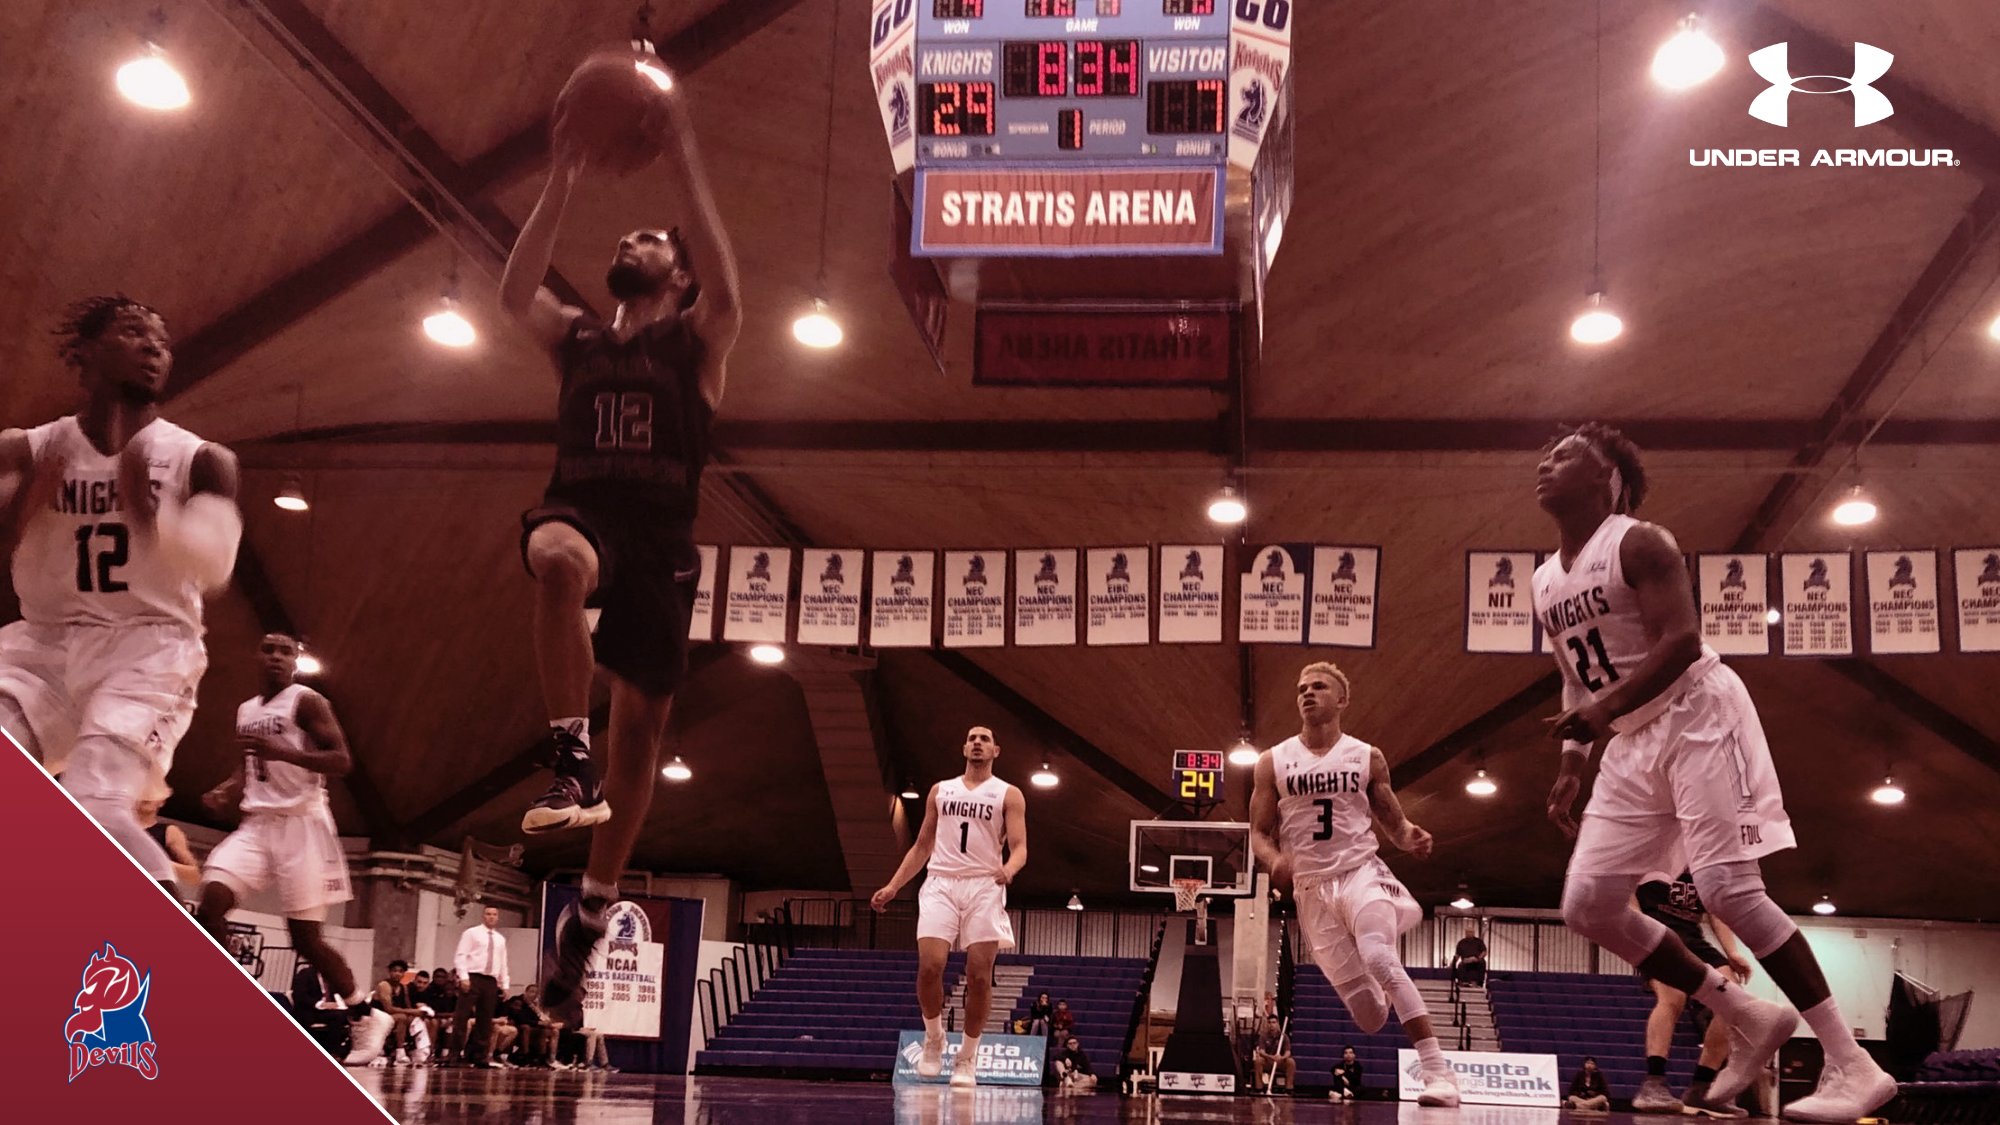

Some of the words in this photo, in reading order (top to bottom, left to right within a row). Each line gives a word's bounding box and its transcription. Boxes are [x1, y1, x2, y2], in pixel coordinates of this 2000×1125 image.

[943, 20, 970, 34] WON
[1066, 18, 1098, 32] GAME
[1173, 16, 1201, 31] WON
[921, 50, 993, 76] KNIGHTS
[1149, 47, 1226, 73] VISITOR
[933, 82, 994, 135] 29
[1196, 79, 1224, 133] 7
[1073, 109, 1081, 149] 1
[1089, 118, 1126, 136] PERIOD
[932, 141, 968, 157] BONUS
[1175, 139, 1211, 156] BONUS
[941, 189, 1076, 228] STRATIS
[1085, 188, 1197, 226] ARENA
[595, 391, 653, 449] 12
[74, 522, 130, 593] 12
[749, 582, 767, 592] NEC
[822, 585, 841, 594] NEC
[893, 586, 912, 596] NEC
[966, 586, 985, 596] NEC
[1037, 585, 1056, 594] NEC
[1182, 582, 1201, 591] NEC
[1262, 582, 1284, 592] NEC
[1334, 584, 1353, 593] NEC
[729, 592, 785, 603] CHAMPIONS
[803, 594, 858, 605] CHAMPIONS
[1018, 595, 1073, 605] CHAMPIONS
[1090, 593, 1146, 605] CHAMPIONS
[1163, 592, 1219, 602] CHAMPIONS
[1314, 594, 1372, 605] CHAMPIONS
[1488, 592, 1515, 608] NIT
[1723, 592, 1744, 601] NEC
[1807, 592, 1827, 601] NEC
[1893, 589, 1914, 599] NEC
[875, 596, 930, 607] CHAMPIONS
[947, 596, 1002, 607] CHAMPIONS
[1703, 603, 1764, 613] CHAMPIONS
[1787, 602, 1848, 613] CHAMPIONS
[1873, 600, 1935, 612] CHAMPIONS
[1543, 586, 1610, 633] KNIGHTS
[1566, 626, 1621, 694] 21
[1187, 753, 1220, 769] 8:34
[1180, 770, 1215, 798] 24
[1286, 771, 1361, 797] KNIGHTS
[942, 800, 994, 821] KNIGHTS
[1312, 798, 1334, 841] 3
[959, 821, 969, 853] 1
[1741, 825, 1763, 846] FDU
[606, 957, 638, 972] NCAA
[612, 972, 655, 984] BASKETBALL
[586, 981, 605, 990] 1963
[613, 983, 631, 992] 1985
[586, 991, 604, 1000] 1998
[611, 992, 631, 1002] 2005
[637, 994, 656, 1003] 2016
[585, 1001, 605, 1010] 2019
[977, 1056, 1039, 1071] Bank
[1486, 1075, 1553, 1091] Bank
